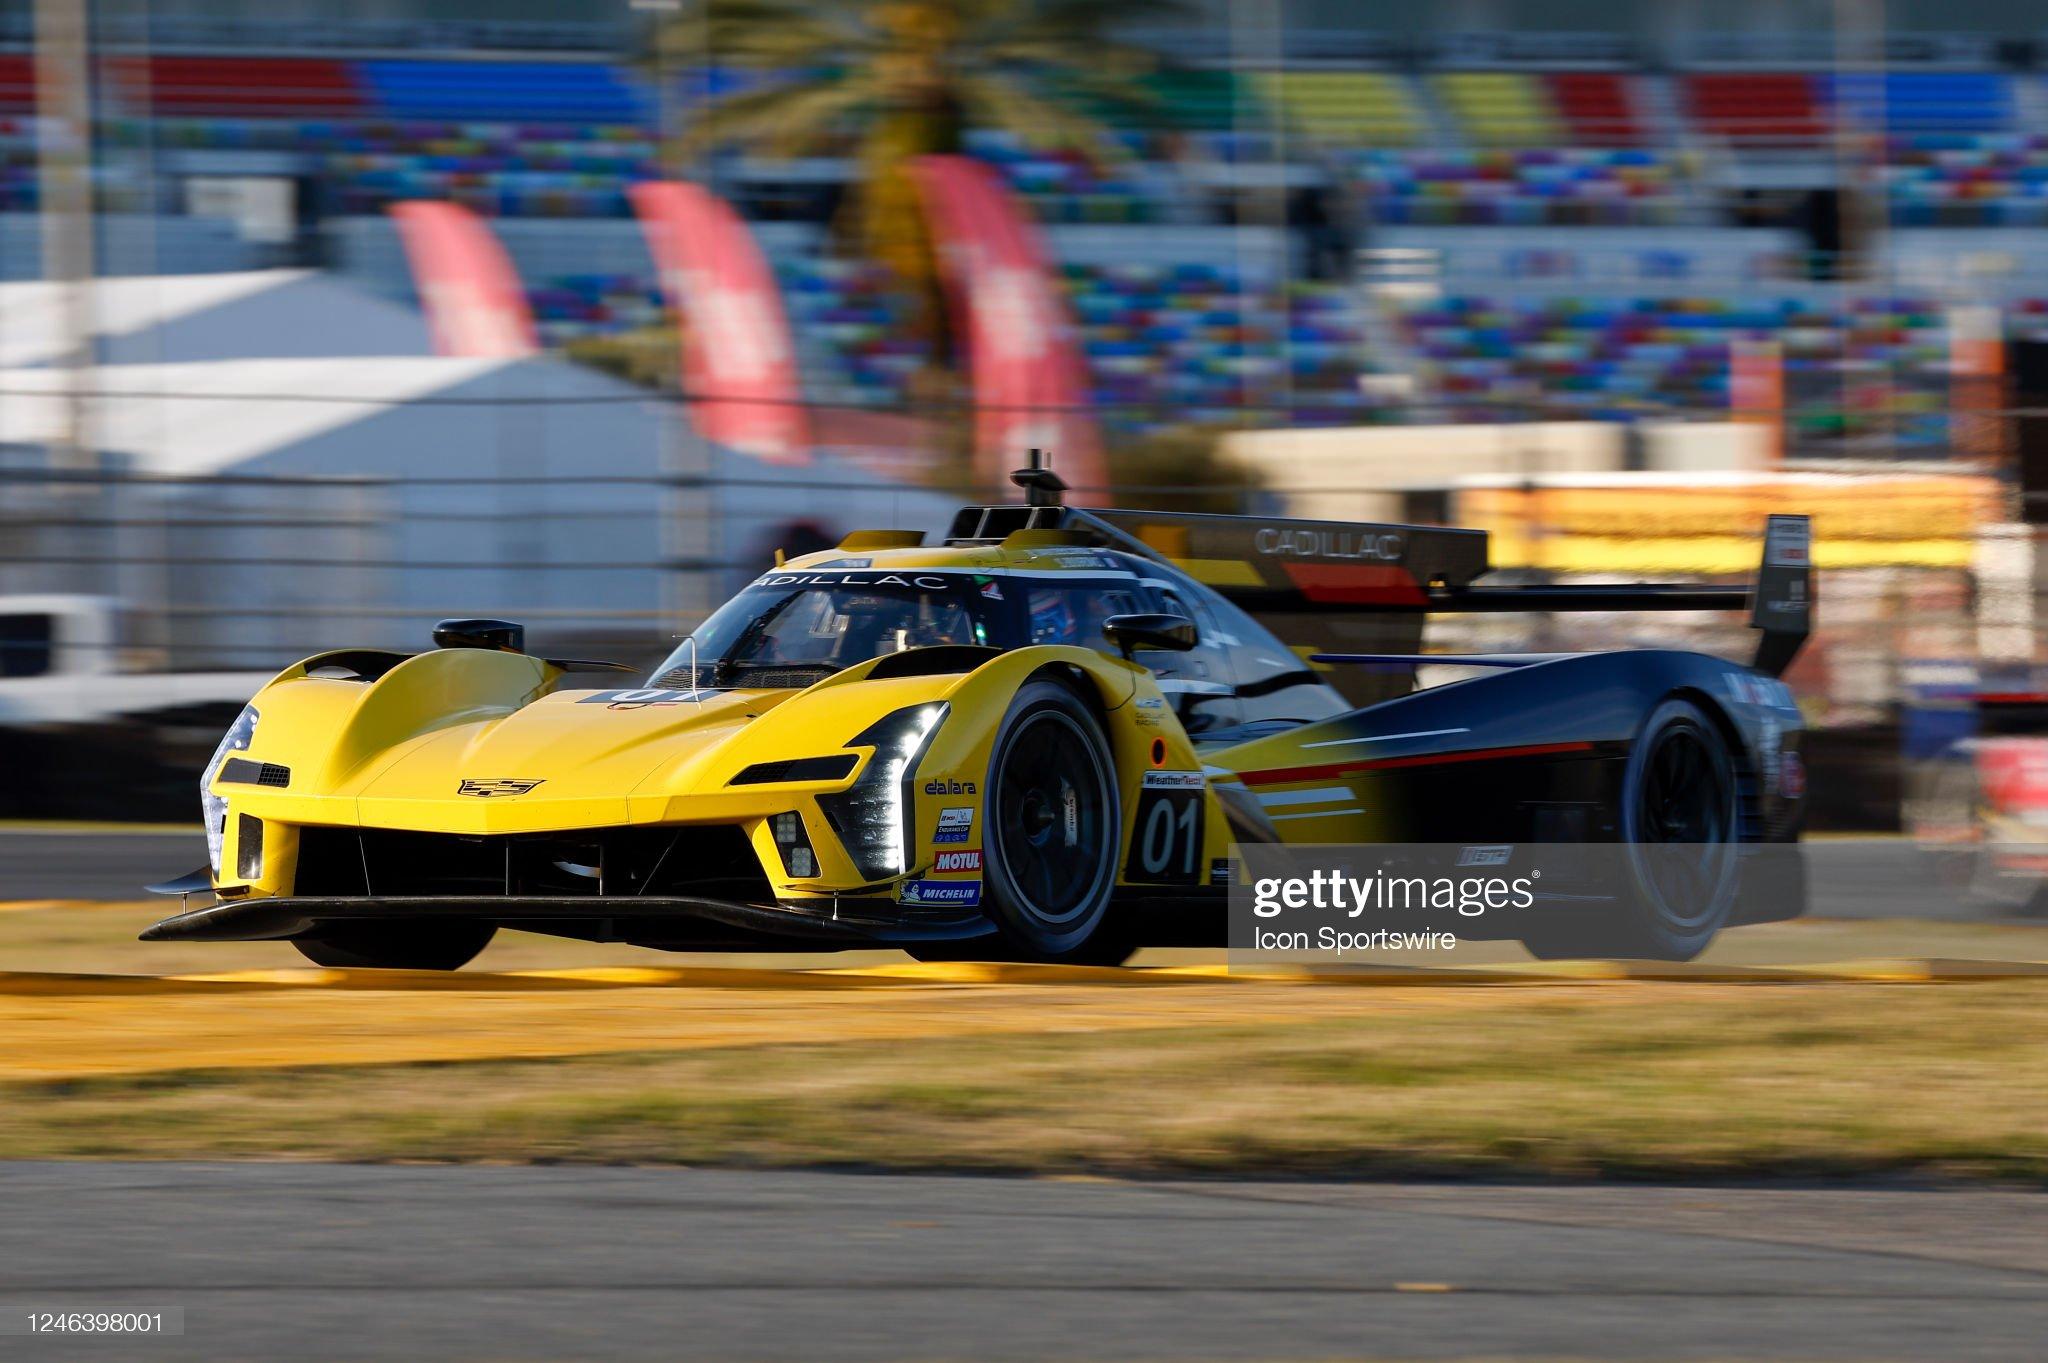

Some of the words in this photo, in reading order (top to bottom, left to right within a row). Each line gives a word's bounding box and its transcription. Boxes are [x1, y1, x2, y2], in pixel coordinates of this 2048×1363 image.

[1255, 528, 1402, 560] CADILLAC
[752, 574, 949, 590] ADILLAC
[925, 778, 976, 795] dallara
[1143, 798, 1197, 874] 01
[936, 852, 980, 870] MOTUL
[922, 888, 976, 899] MICHELIN
